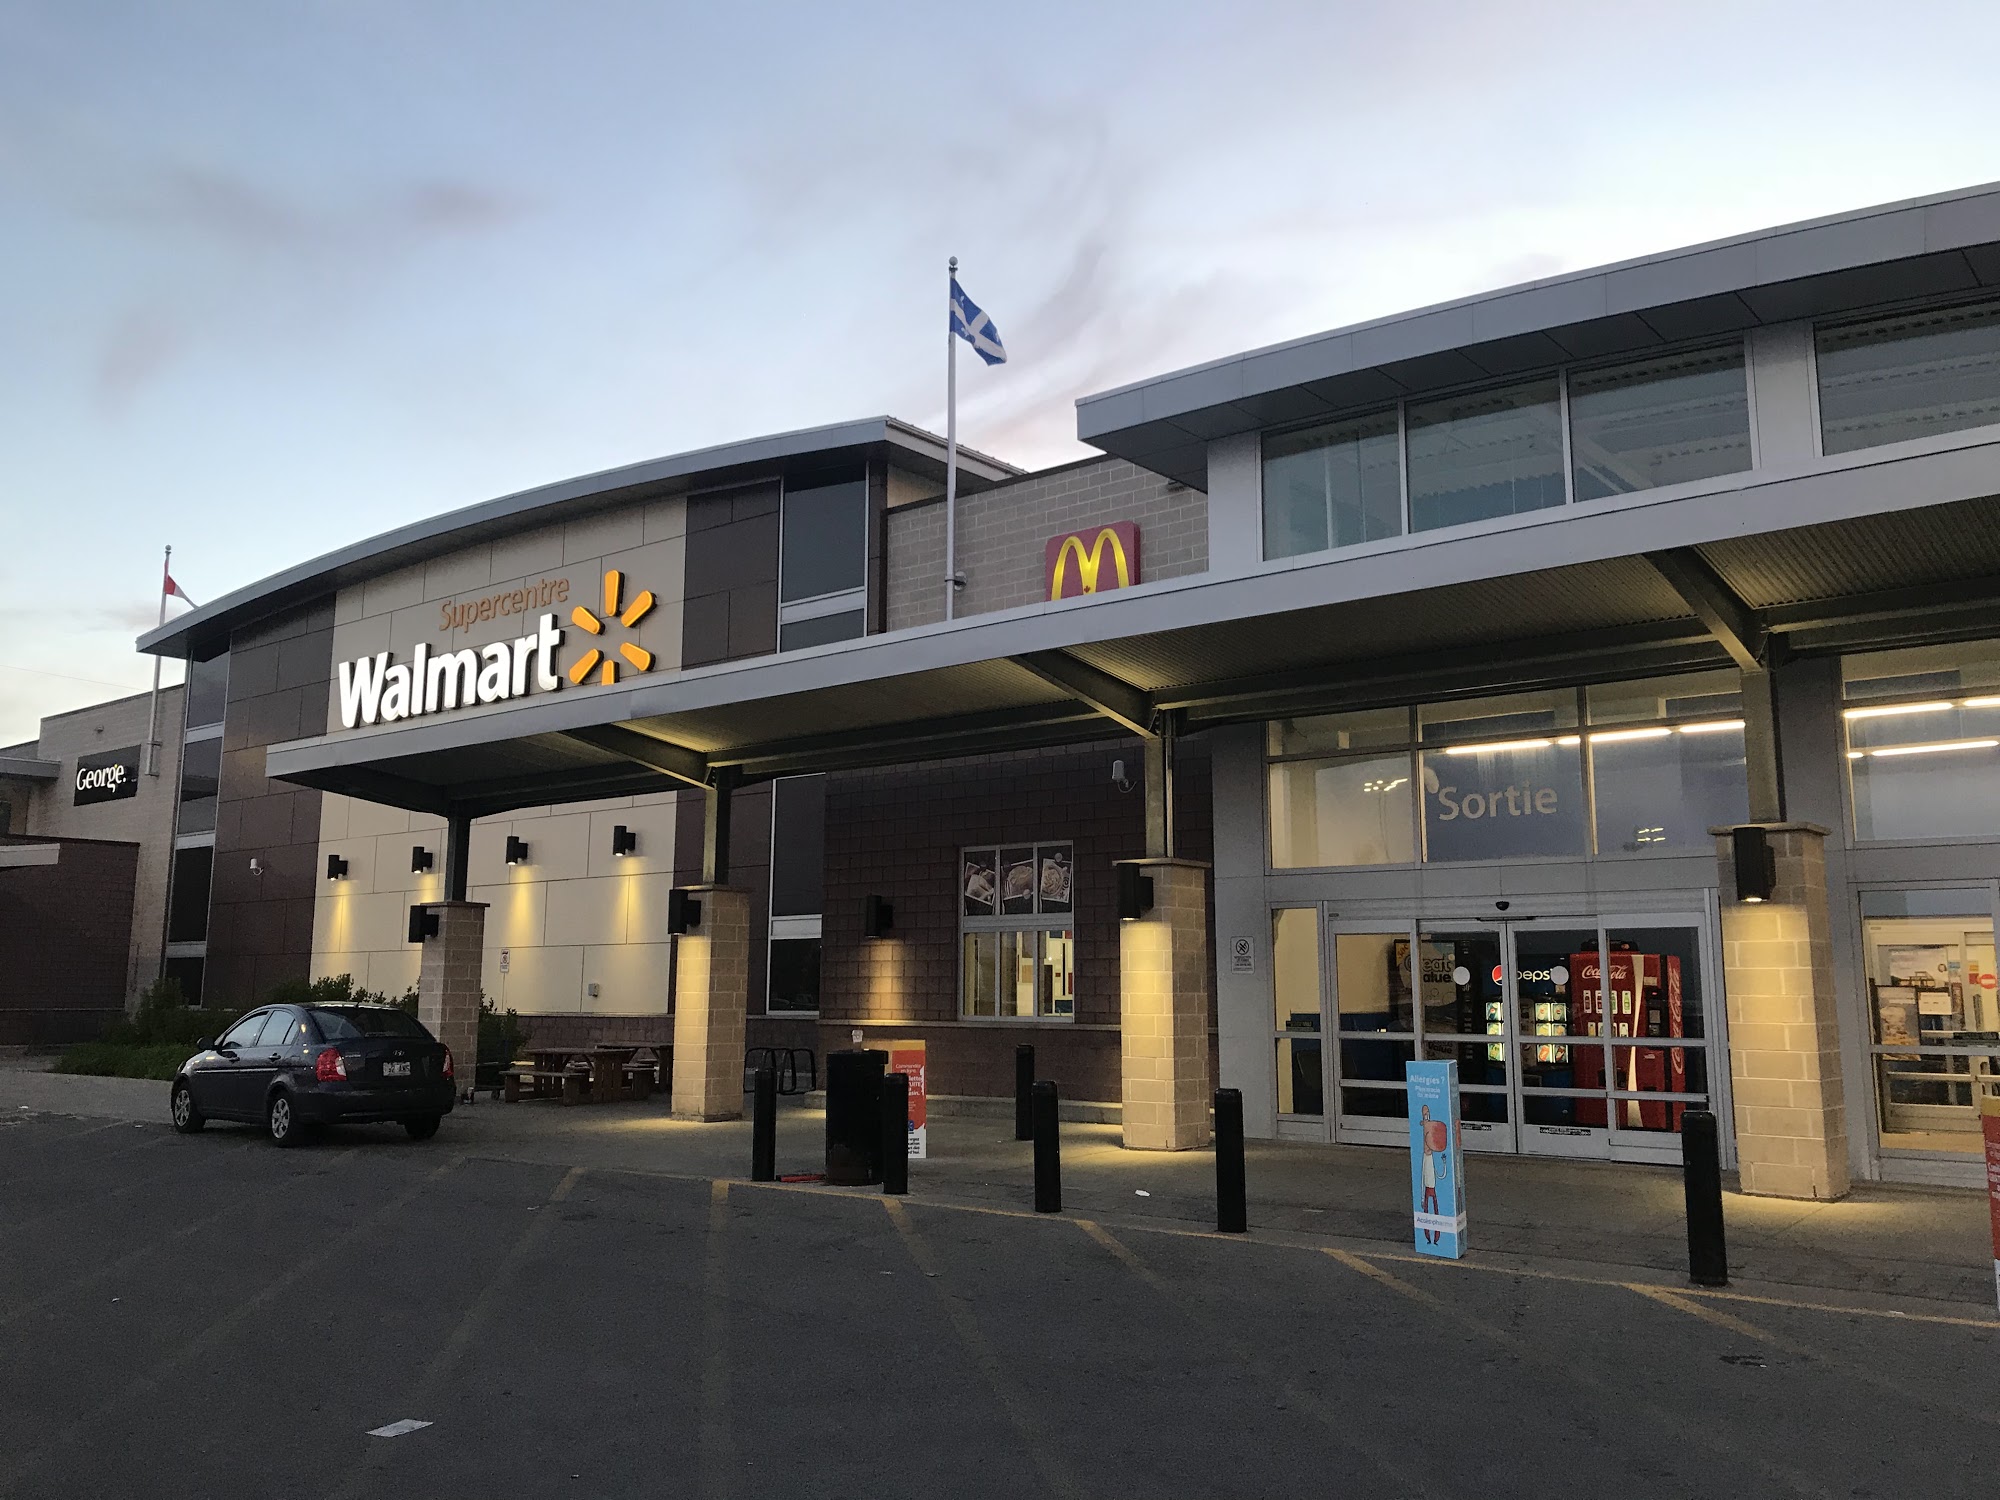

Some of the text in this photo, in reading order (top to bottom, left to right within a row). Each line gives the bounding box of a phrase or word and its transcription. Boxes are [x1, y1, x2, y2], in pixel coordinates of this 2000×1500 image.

[438, 577, 570, 634] Supercentre
[338, 612, 566, 729] Walmart
[1438, 780, 1559, 821] Sortie
[1422, 972, 1453, 984] alue
[1409, 1074, 1440, 1085] Allergies
